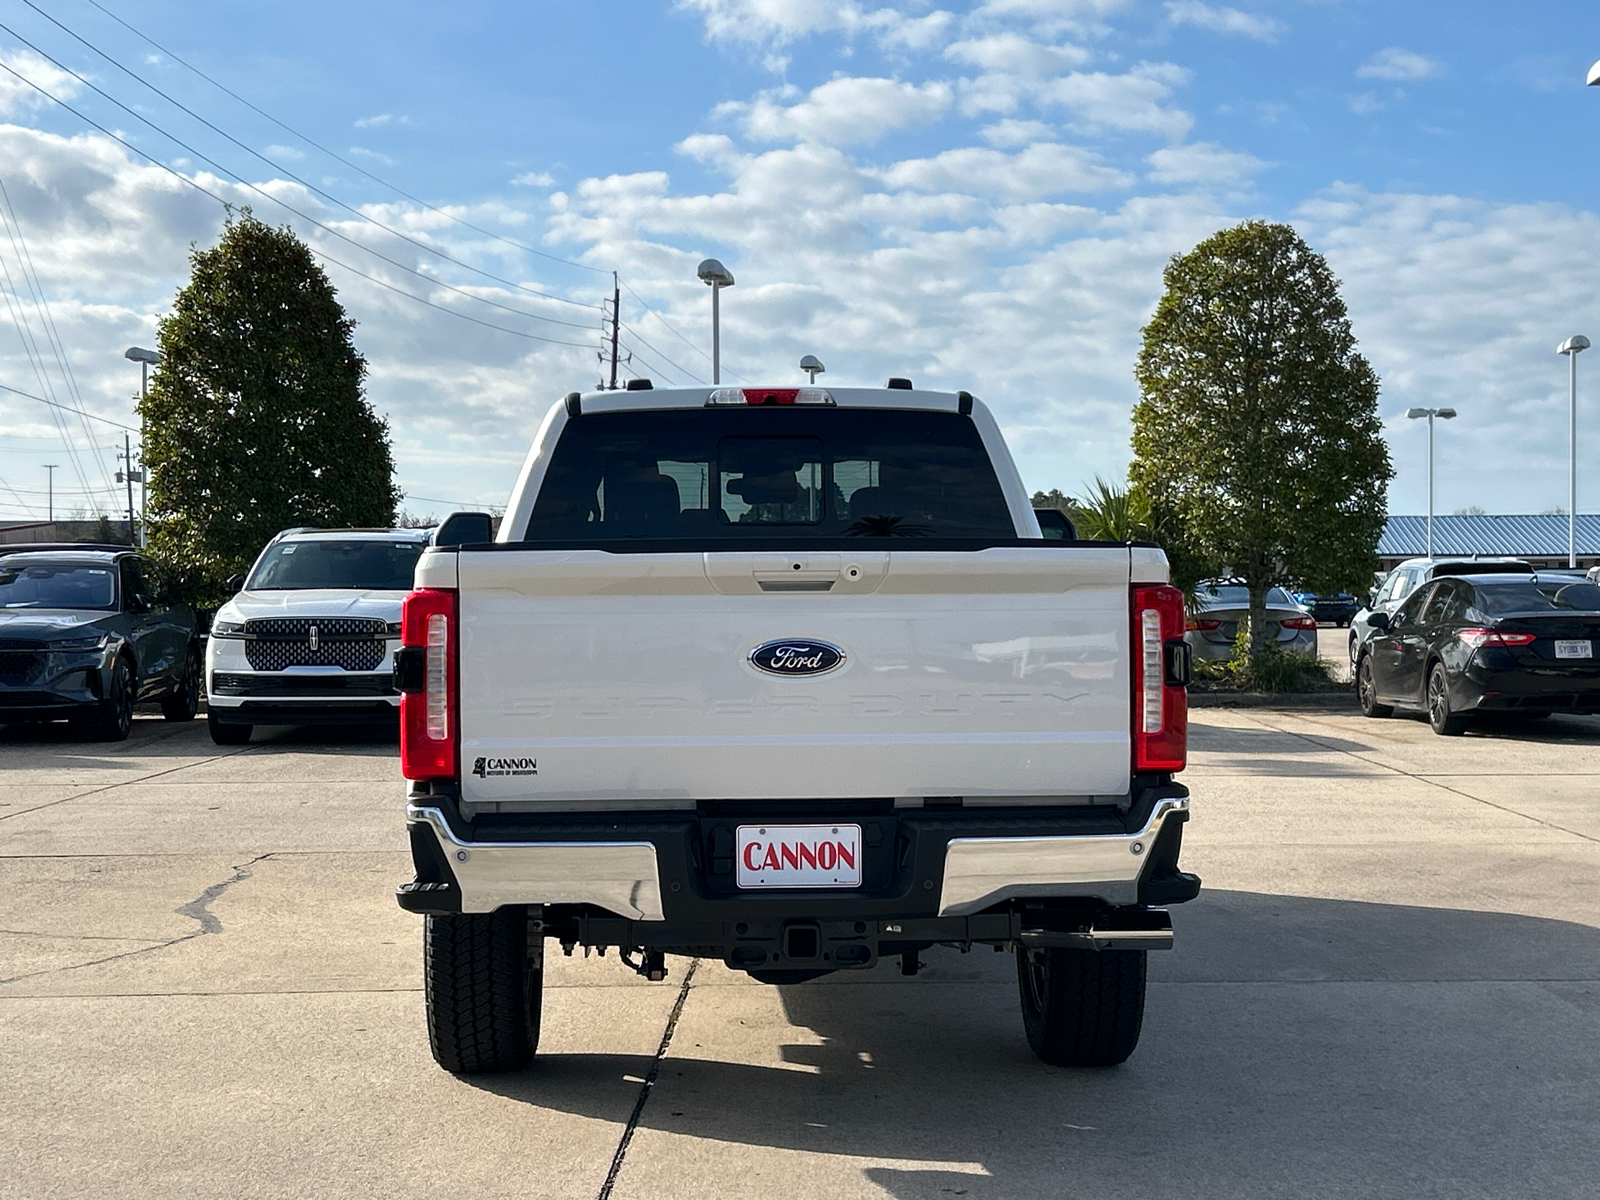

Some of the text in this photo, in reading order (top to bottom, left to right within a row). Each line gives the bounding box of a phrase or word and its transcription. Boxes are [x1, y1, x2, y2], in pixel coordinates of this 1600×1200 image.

[770, 646, 823, 668] Ford
[500, 693, 1091, 718] SUPER DUTY
[487, 758, 537, 769] CANNON
[743, 841, 855, 871] CANNON
